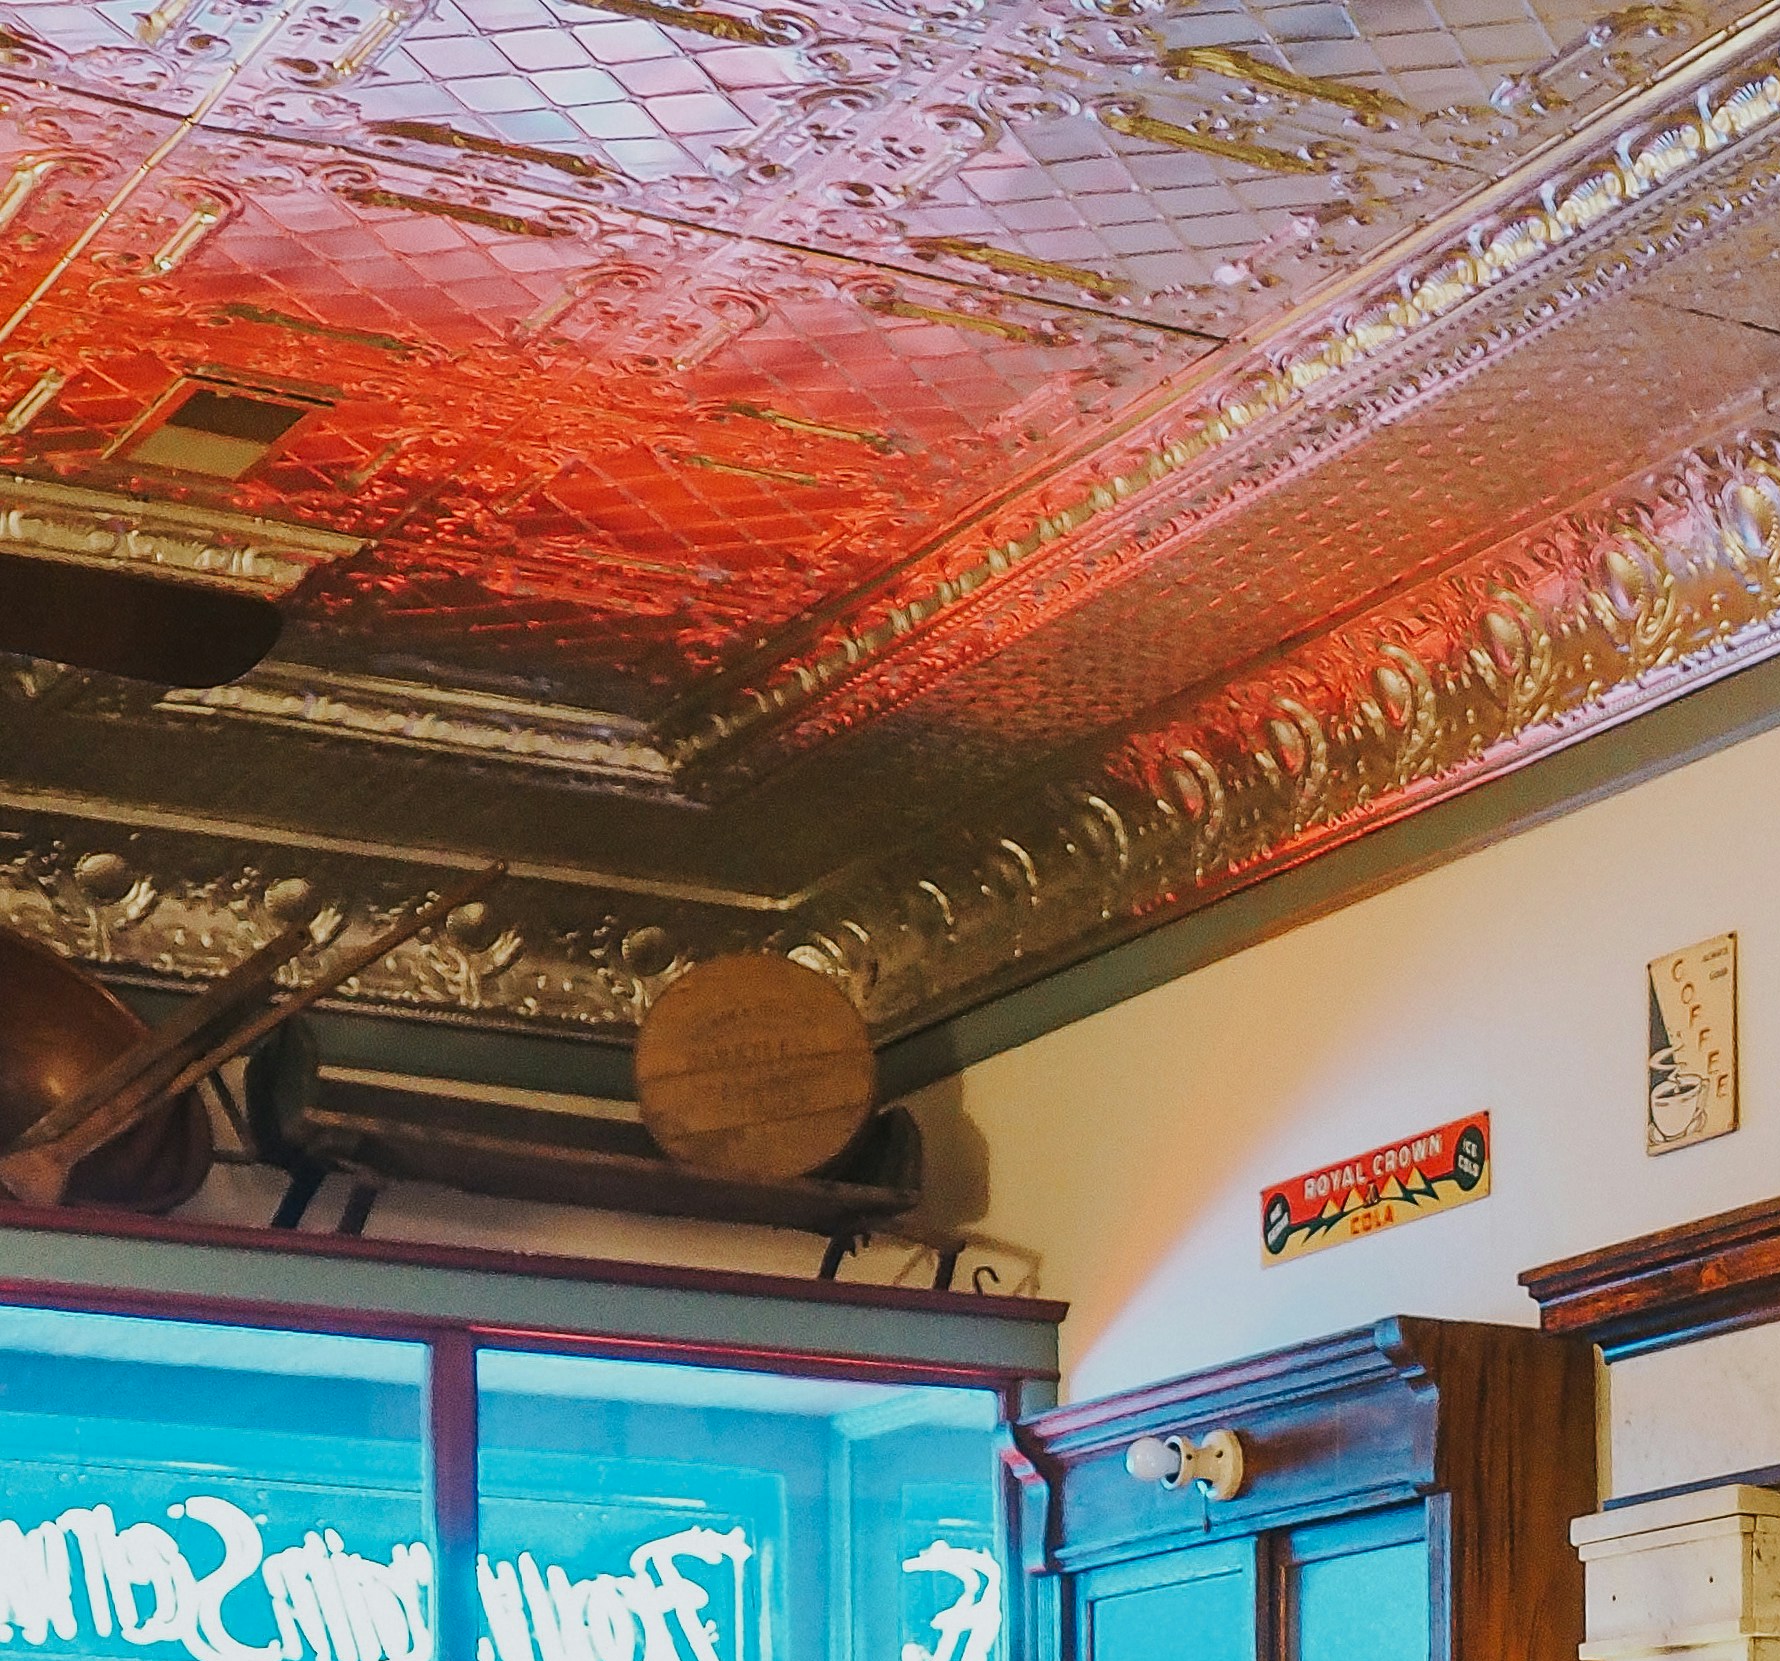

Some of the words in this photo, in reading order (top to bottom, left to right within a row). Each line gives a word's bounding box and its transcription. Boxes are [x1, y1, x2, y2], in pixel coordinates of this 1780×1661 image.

[1672, 957, 1728, 1099] COFFEE
[1304, 1161, 1368, 1201] ROYAL
[1373, 1133, 1444, 1178] CROWN
[1349, 1204, 1395, 1236] COLA
